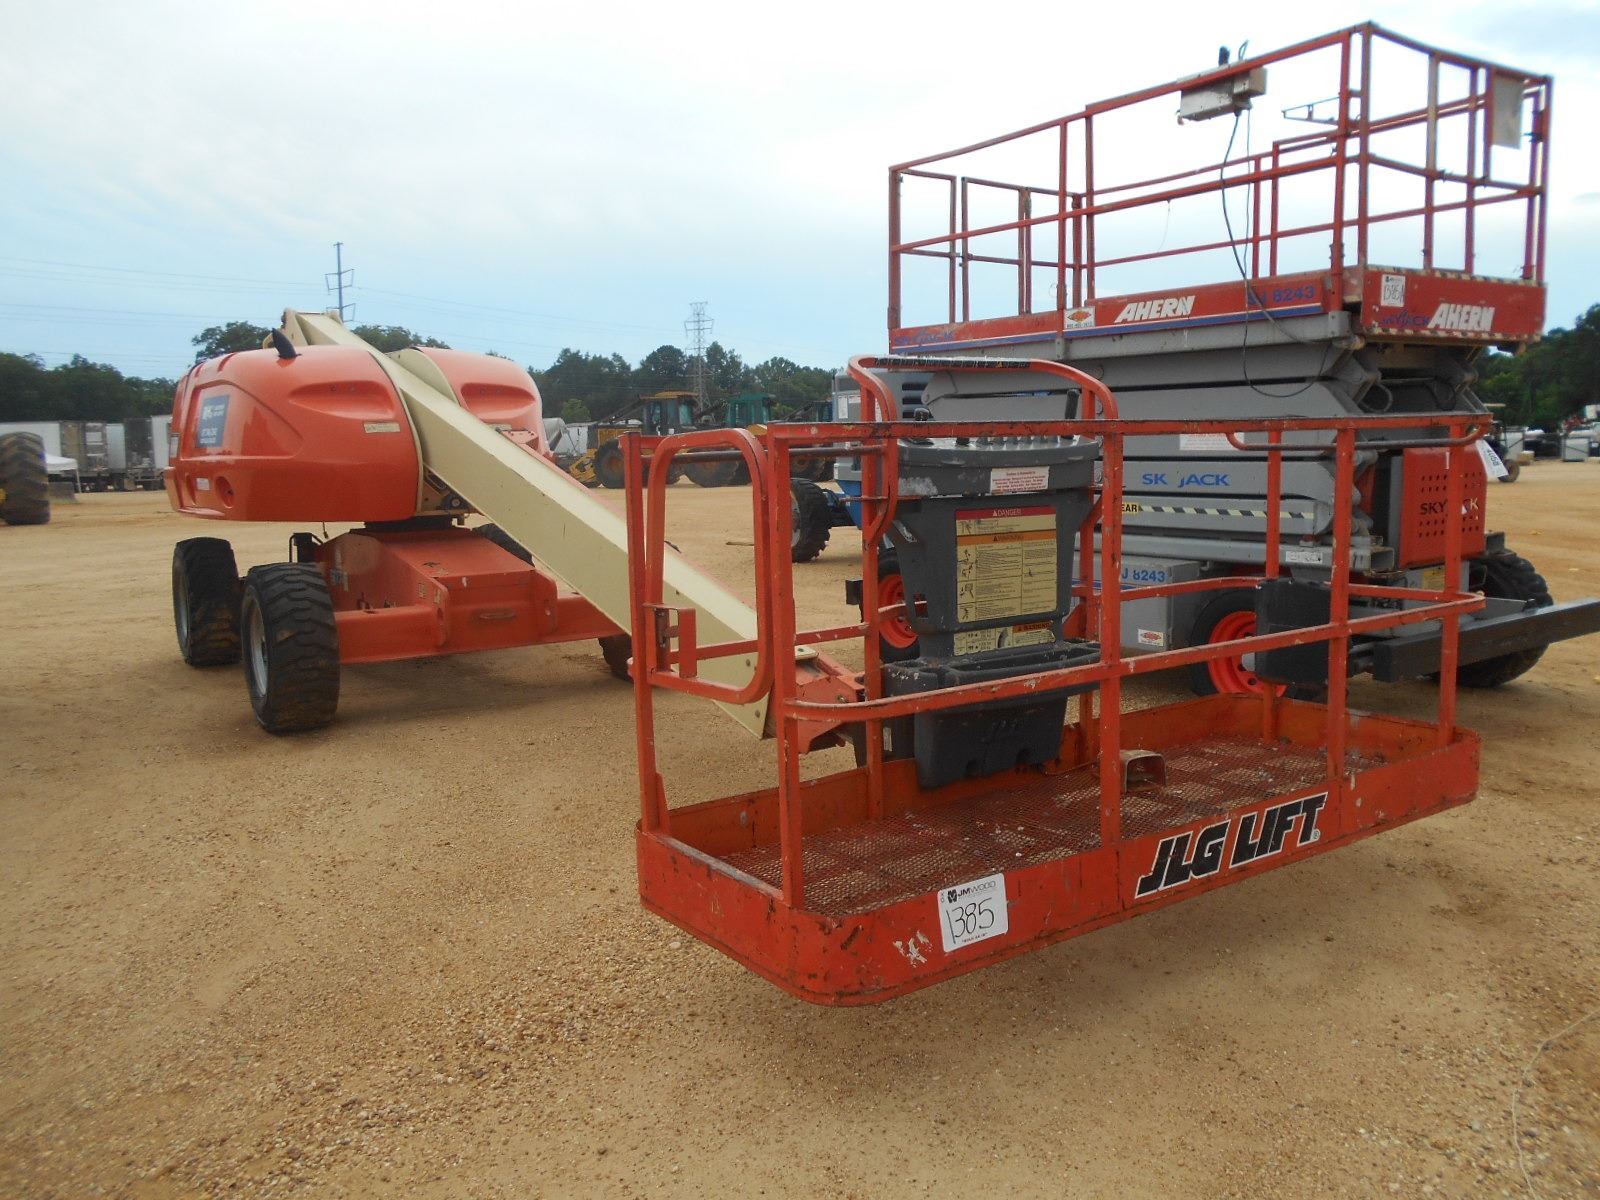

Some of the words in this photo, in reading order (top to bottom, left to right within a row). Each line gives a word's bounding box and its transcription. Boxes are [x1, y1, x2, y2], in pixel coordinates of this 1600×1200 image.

[1273, 285, 1315, 303] 8243
[1114, 296, 1195, 323] AHERN
[1427, 303, 1495, 331] AHERN
[1132, 569, 1166, 583] 8243
[1134, 819, 1232, 899] JLG
[1228, 791, 1329, 869] LIFT
[945, 896, 995, 944] 1385
